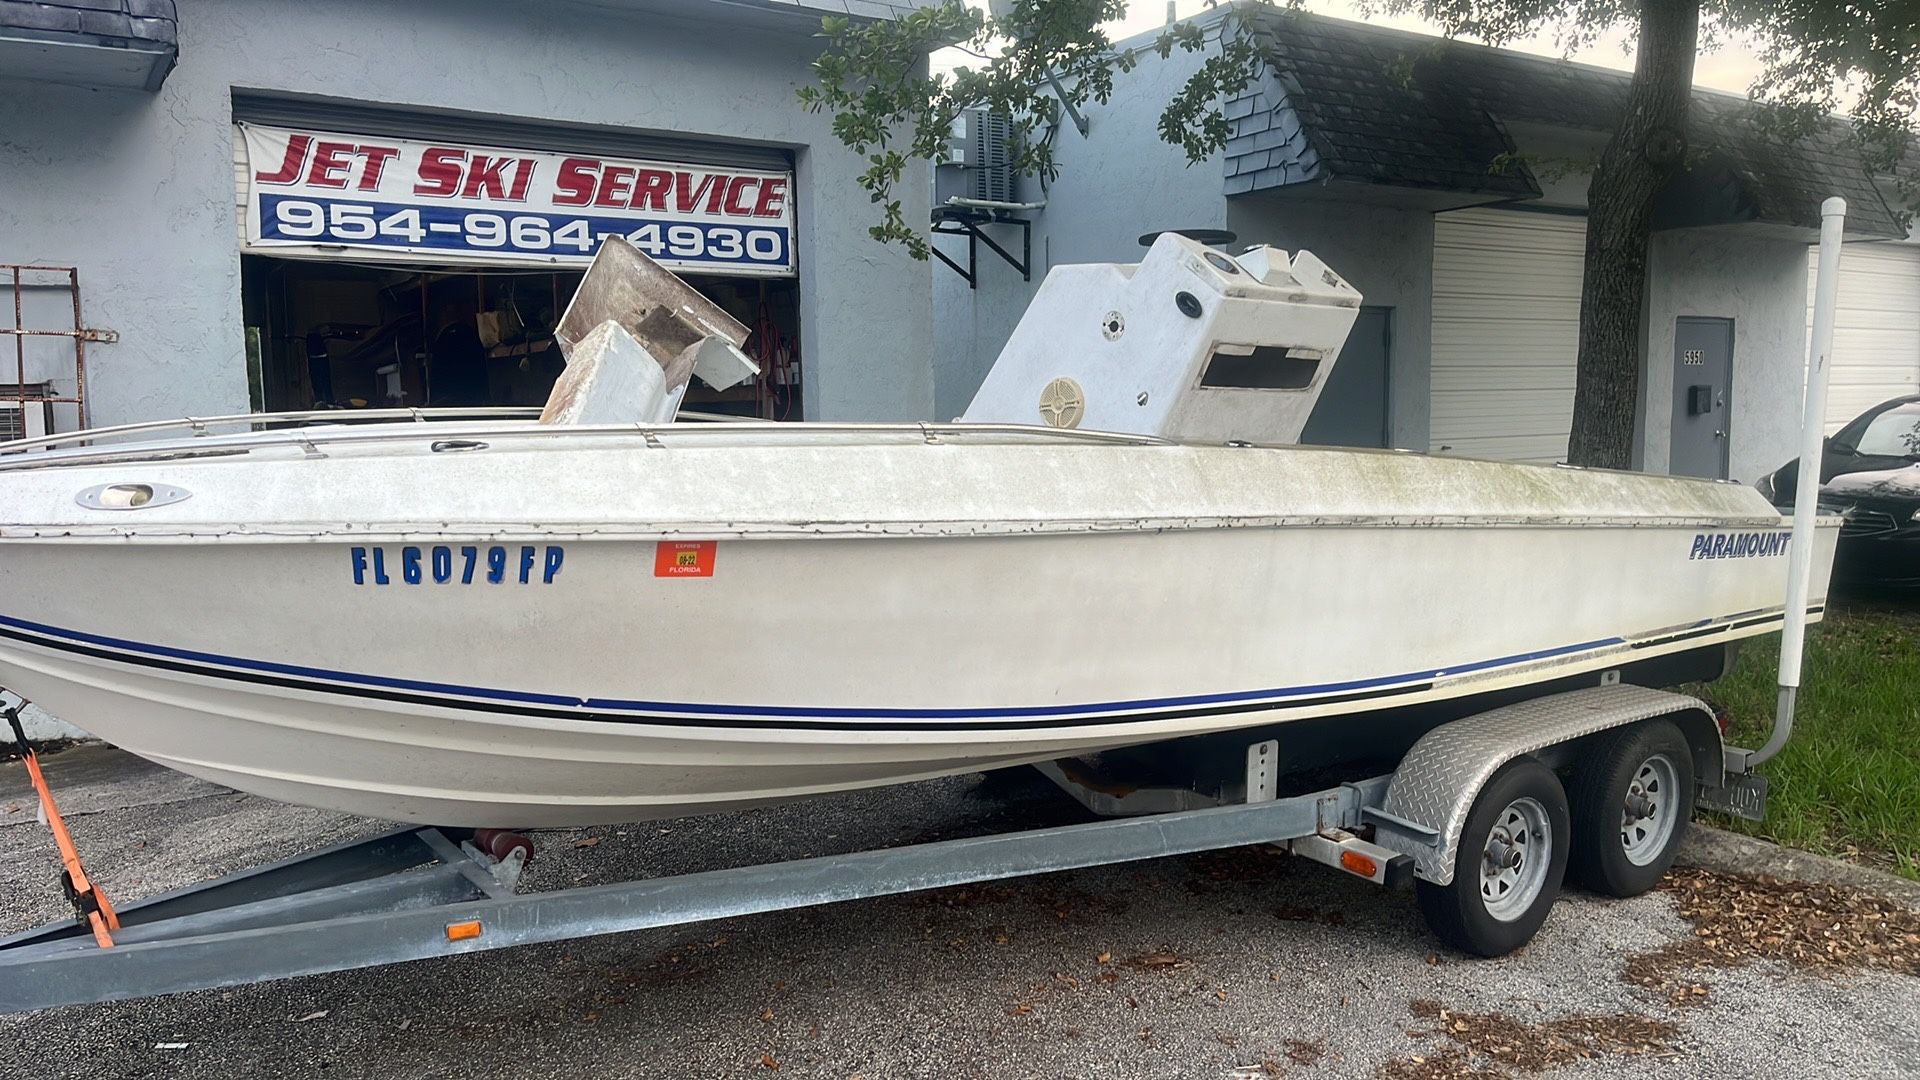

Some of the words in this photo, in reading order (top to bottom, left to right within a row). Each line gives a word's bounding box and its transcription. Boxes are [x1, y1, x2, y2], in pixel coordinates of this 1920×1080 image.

[255, 134, 399, 192] JET
[413, 147, 538, 203] SKI
[551, 158, 788, 219] SERVICE
[276, 200, 782, 260] 954-964-4930
[1684, 350, 1704, 365] 5950
[351, 547, 389, 585] FL
[402, 546, 507, 585] 6079
[519, 546, 565, 584] FP
[1689, 532, 1792, 560] PARAMOUNT
